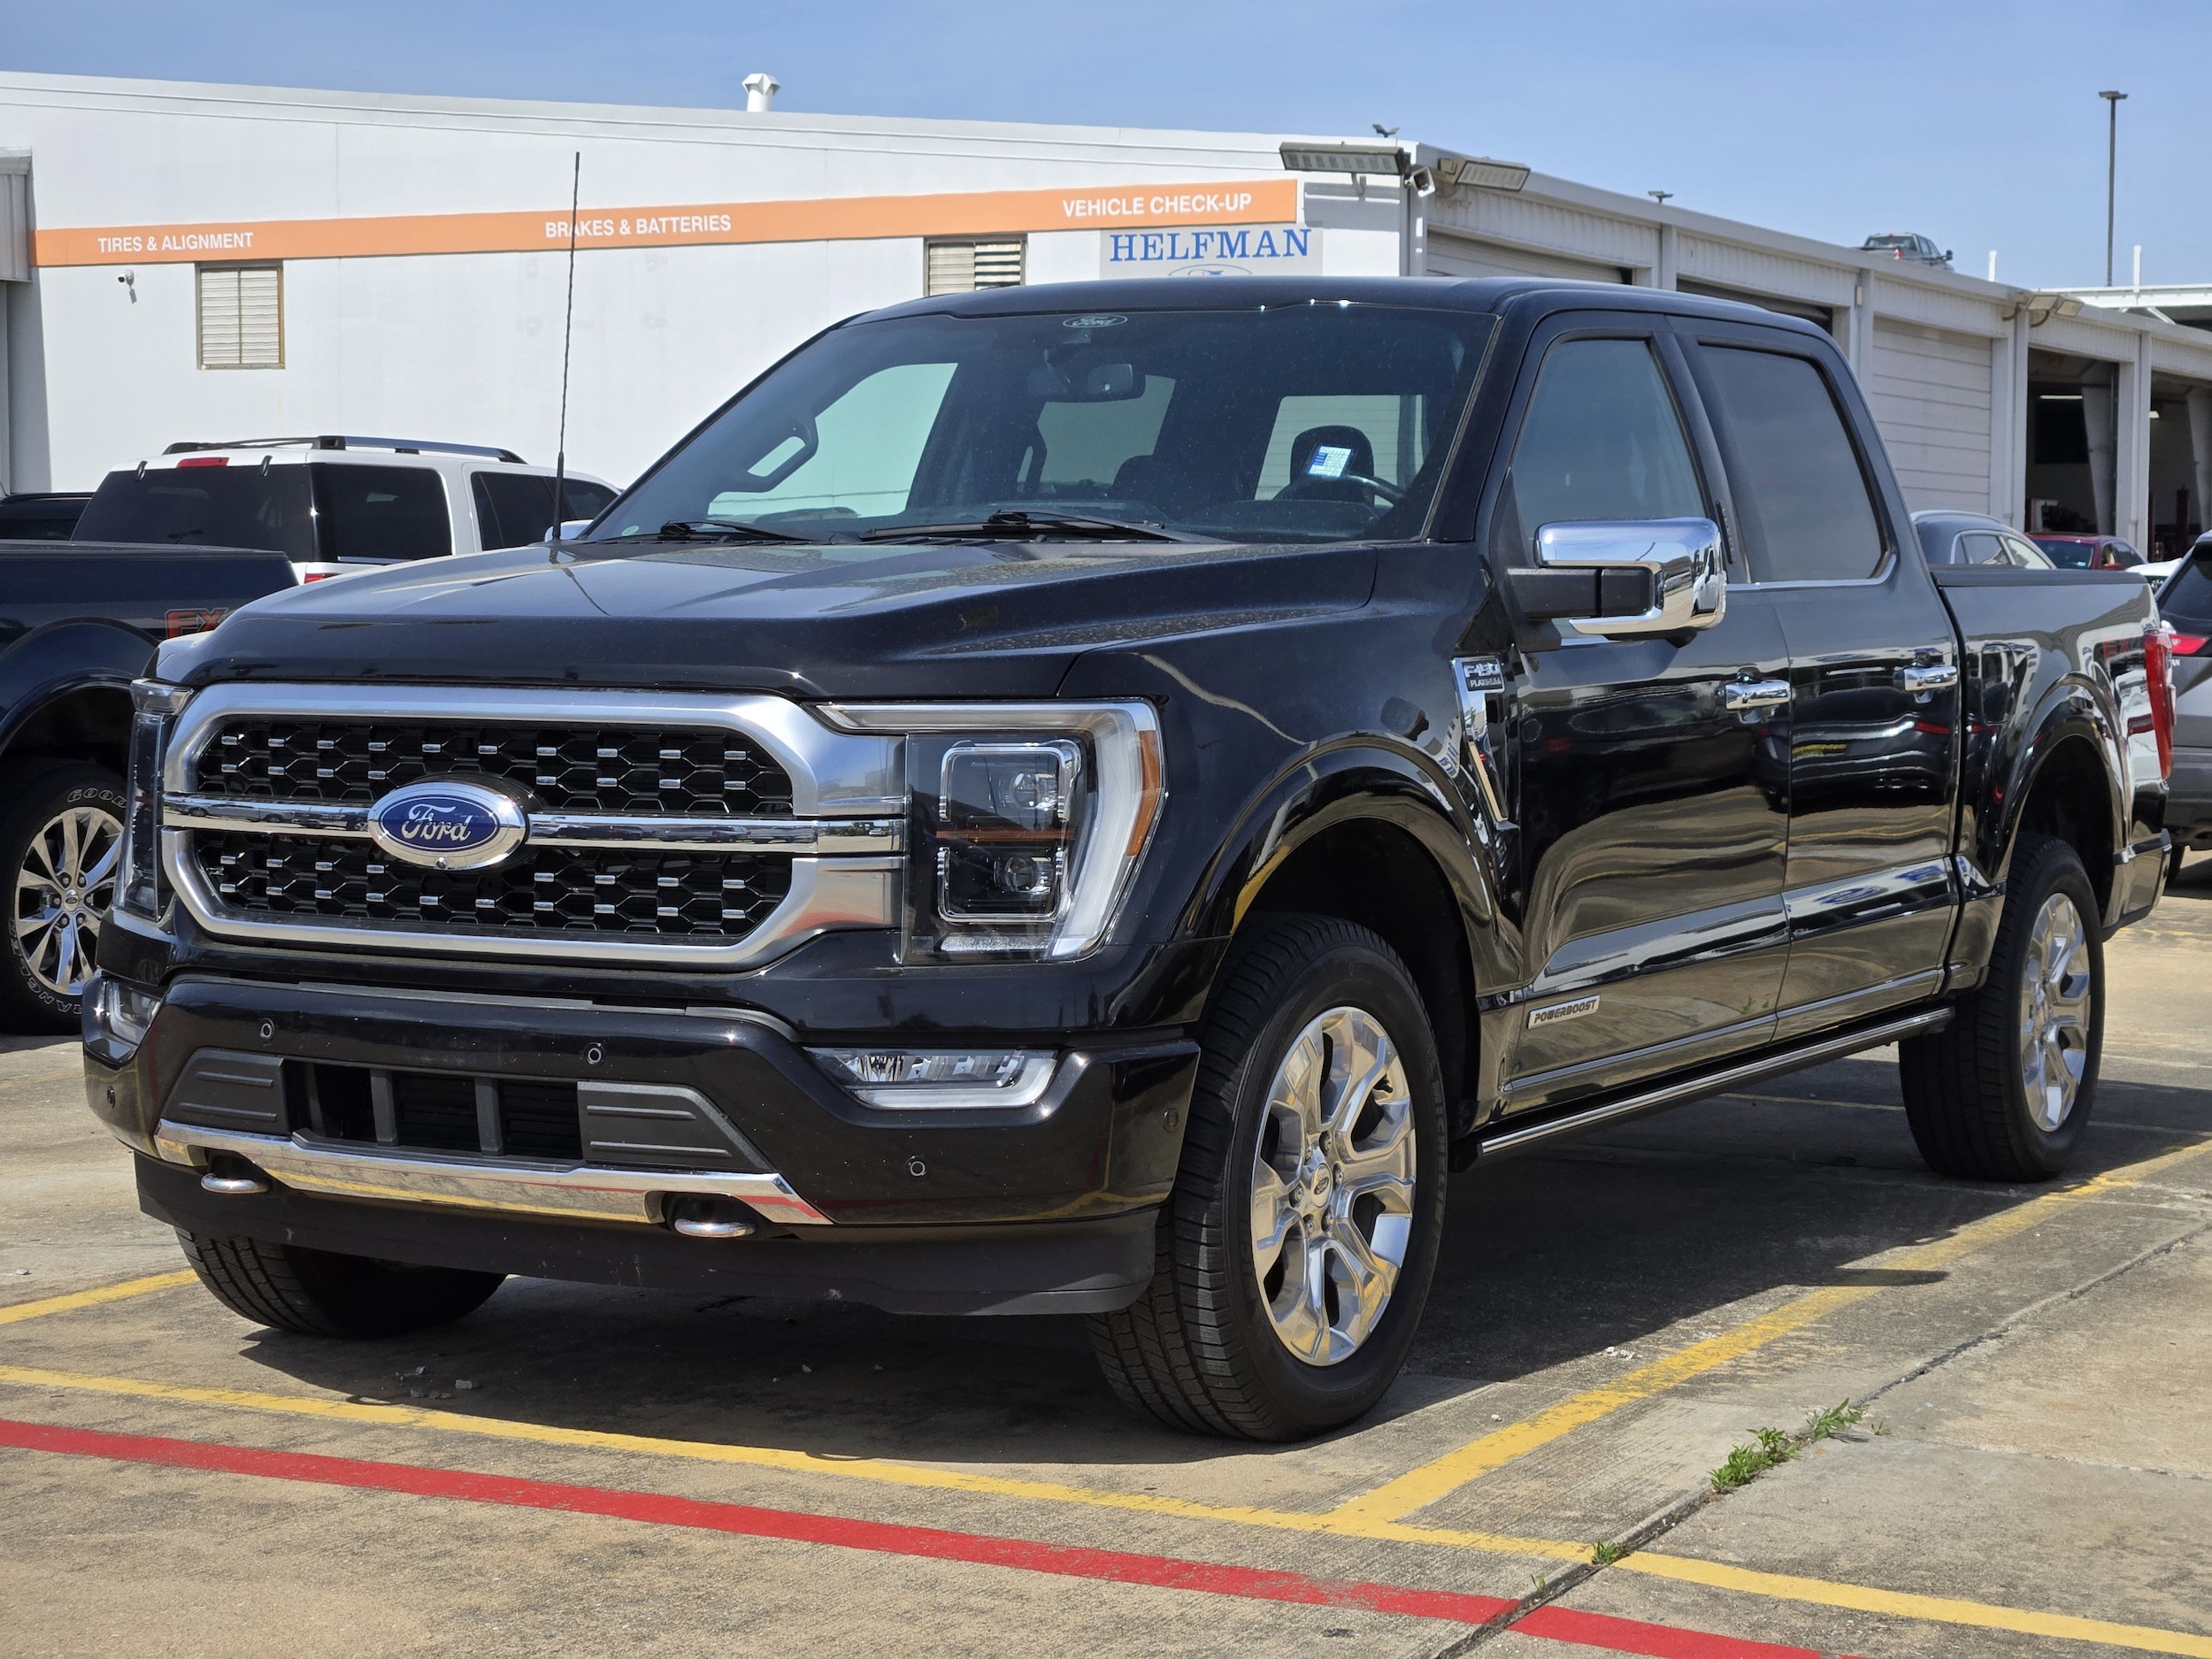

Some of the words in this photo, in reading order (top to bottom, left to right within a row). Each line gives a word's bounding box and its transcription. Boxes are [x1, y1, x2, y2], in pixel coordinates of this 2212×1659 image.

[1063, 196, 1145, 218] VEHICLE
[1150, 193, 1252, 213] CHECK-UP
[545, 219, 615, 237] BRAKES
[618, 219, 632, 234] &
[636, 214, 732, 234] BATTERIES
[98, 236, 142, 253] TIRES
[147, 236, 157, 251] &
[162, 233, 254, 250] ALIGNMENT
[1110, 228, 1312, 262] HELFMAN
[165, 608, 233, 639] FX
[401, 803, 473, 841] Ford
[1533, 999, 1597, 1024] POWERBOOST
